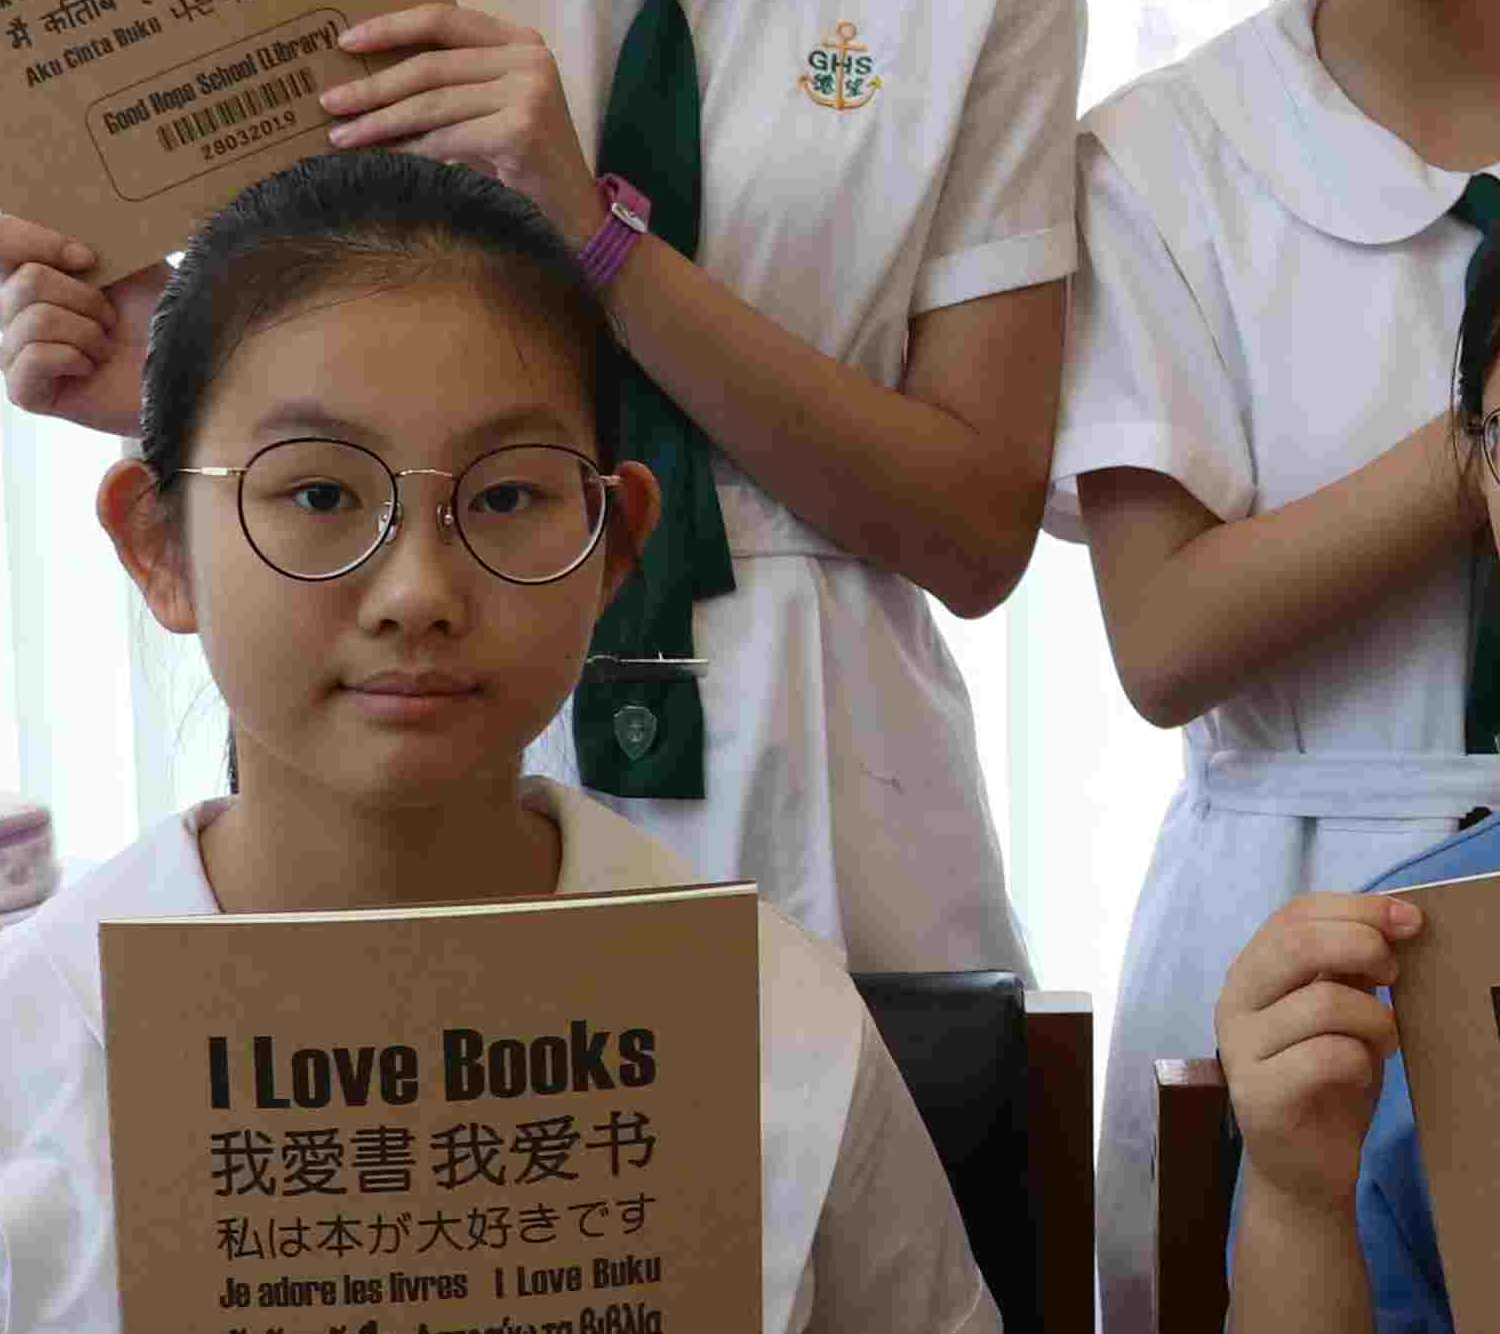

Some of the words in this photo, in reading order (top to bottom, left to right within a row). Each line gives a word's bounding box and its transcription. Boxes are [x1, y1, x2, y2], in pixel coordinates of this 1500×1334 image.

[808, 50, 873, 75] GHS
[208, 1036, 230, 1109] I
[253, 1035, 418, 1109] Love
[443, 1019, 656, 1102] Books
[210, 1125, 416, 1197] 我愛書
[430, 1111, 656, 1190] 我爱书
[217, 1192, 656, 1261] 私は本が大好きです
[219, 1277, 250, 1309] Je
[258, 1276, 336, 1307] adore
[343, 1274, 382, 1305] les
[389, 1271, 468, 1303] livres
[495, 1267, 504, 1299] I
[517, 1266, 582, 1296] Love
[593, 1254, 661, 1288] Buku
